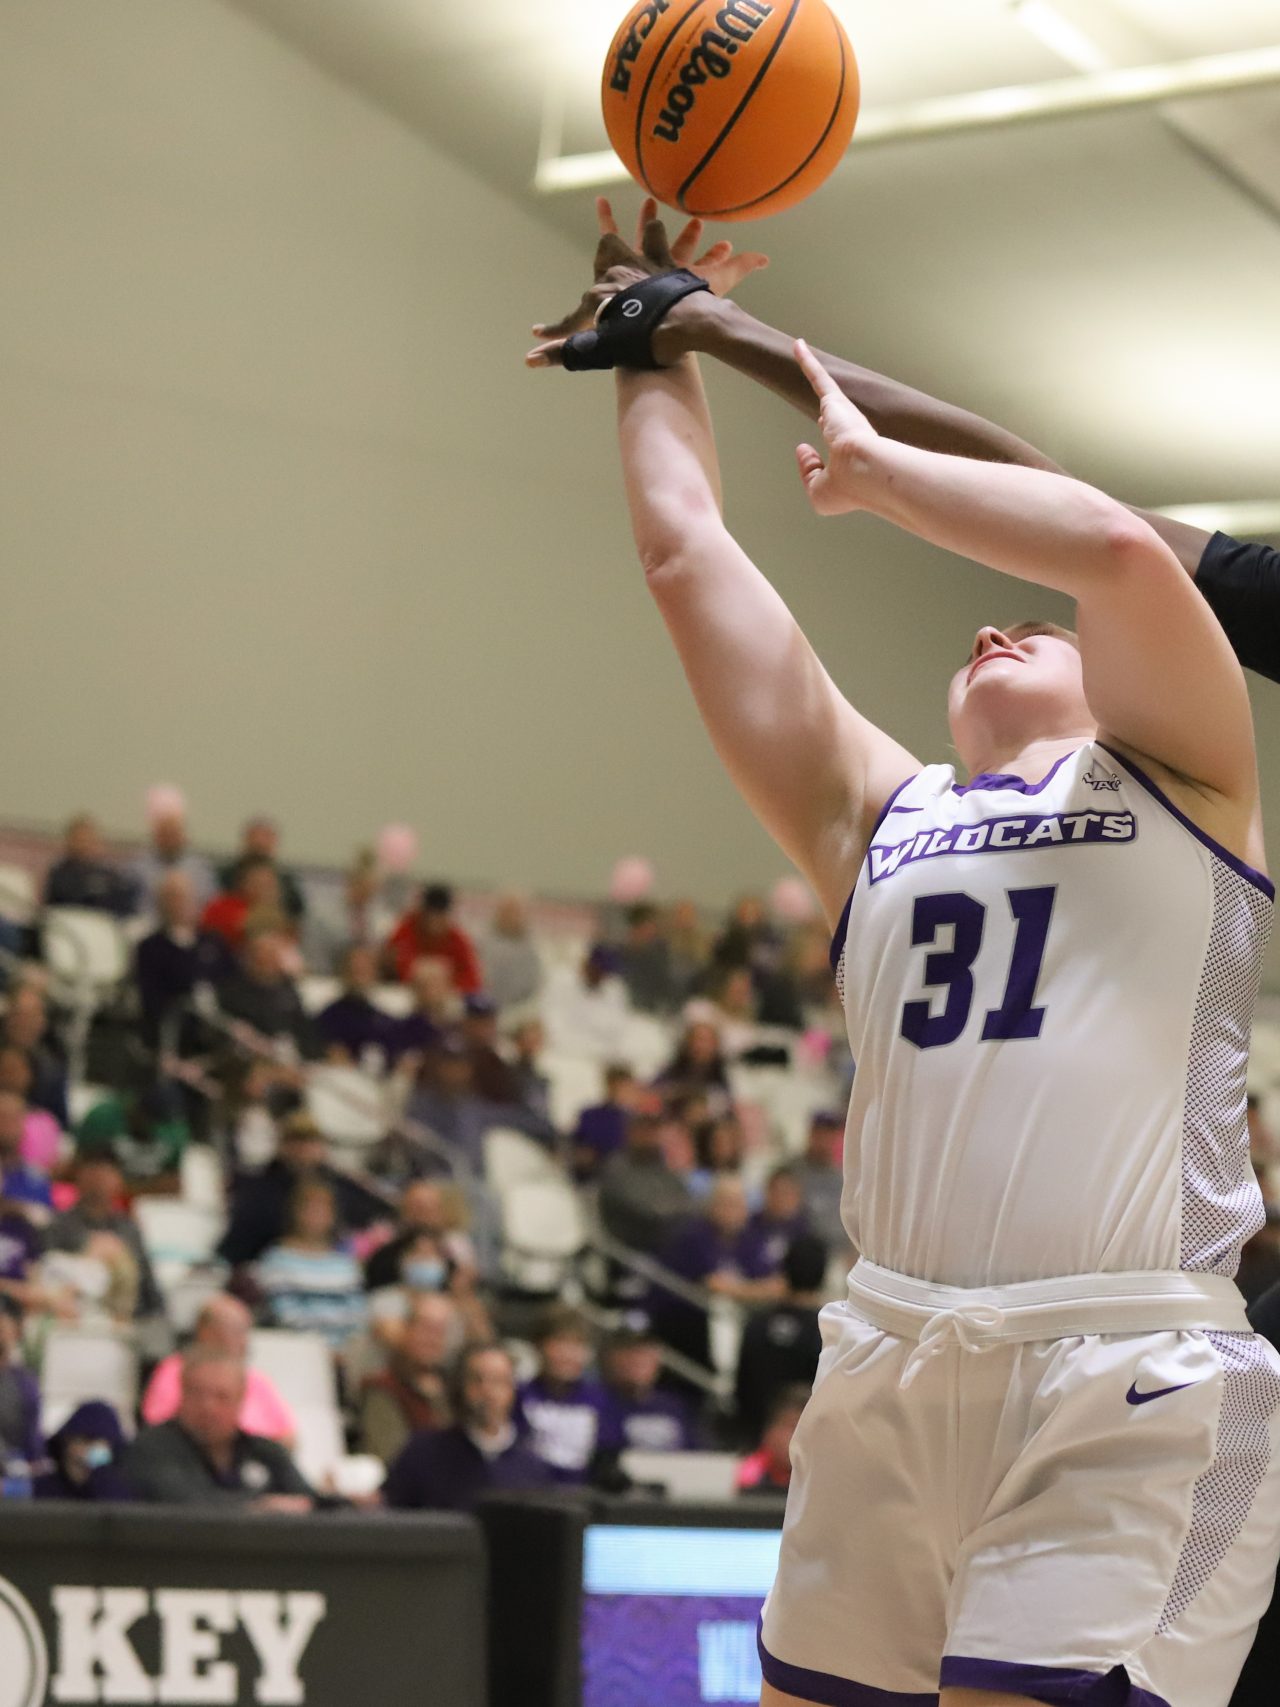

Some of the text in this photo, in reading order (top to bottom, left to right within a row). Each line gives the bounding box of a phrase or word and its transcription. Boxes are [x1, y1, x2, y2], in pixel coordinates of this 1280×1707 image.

[610, 0, 669, 93] CAA
[869, 812, 1137, 882] WILDCATS
[901, 884, 1060, 1051] 31
[50, 1585, 326, 1705] KEY
